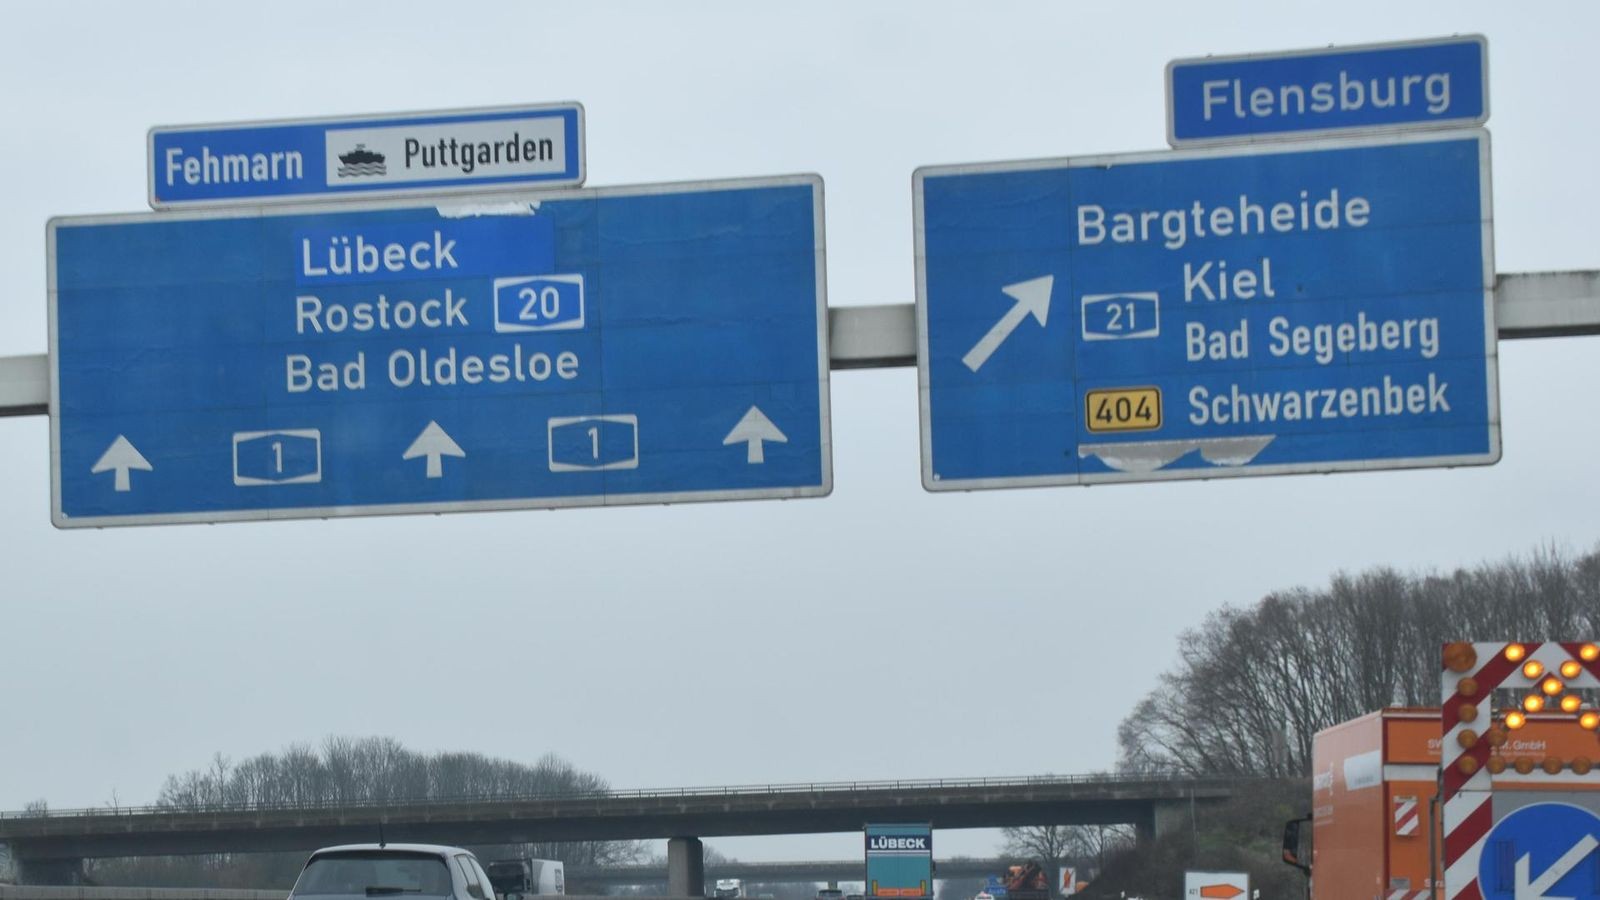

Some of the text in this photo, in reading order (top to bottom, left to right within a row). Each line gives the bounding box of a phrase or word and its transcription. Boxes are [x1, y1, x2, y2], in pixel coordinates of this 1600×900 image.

[1203, 71, 1452, 120] Flensburg
[166, 146, 303, 186] Fehmarn
[405, 132, 553, 173] Puttgarden
[1078, 188, 1370, 250] Bargteheide
[302, 230, 458, 276] Lübeck
[1183, 257, 1275, 302] Kiel
[296, 288, 469, 334] Rostock
[517, 286, 561, 320] 20
[1106, 303, 1137, 331] 21
[1185, 311, 1440, 365] Bad Segeberg
[286, 343, 579, 393] Bad Oldesloe
[1095, 395, 1151, 426] 404
[1188, 373, 1451, 425] Schwarzenbek
[271, 442, 283, 473] 1
[588, 427, 599, 459] 1
[871, 836, 926, 849] LÜBECK
